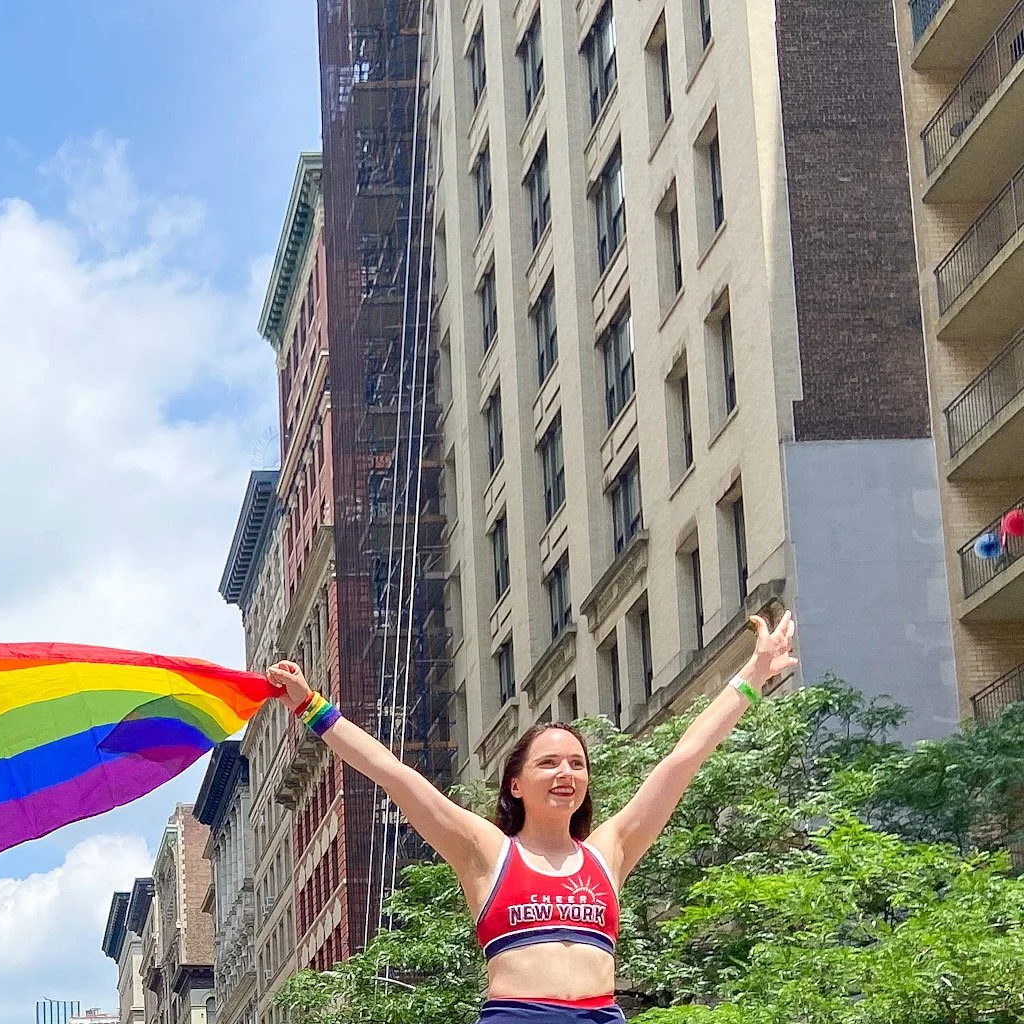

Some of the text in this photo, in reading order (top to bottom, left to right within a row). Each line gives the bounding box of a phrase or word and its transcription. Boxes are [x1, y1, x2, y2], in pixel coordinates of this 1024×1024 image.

[530, 894, 588, 904] CHEER
[508, 904, 607, 926] NEW YORK
